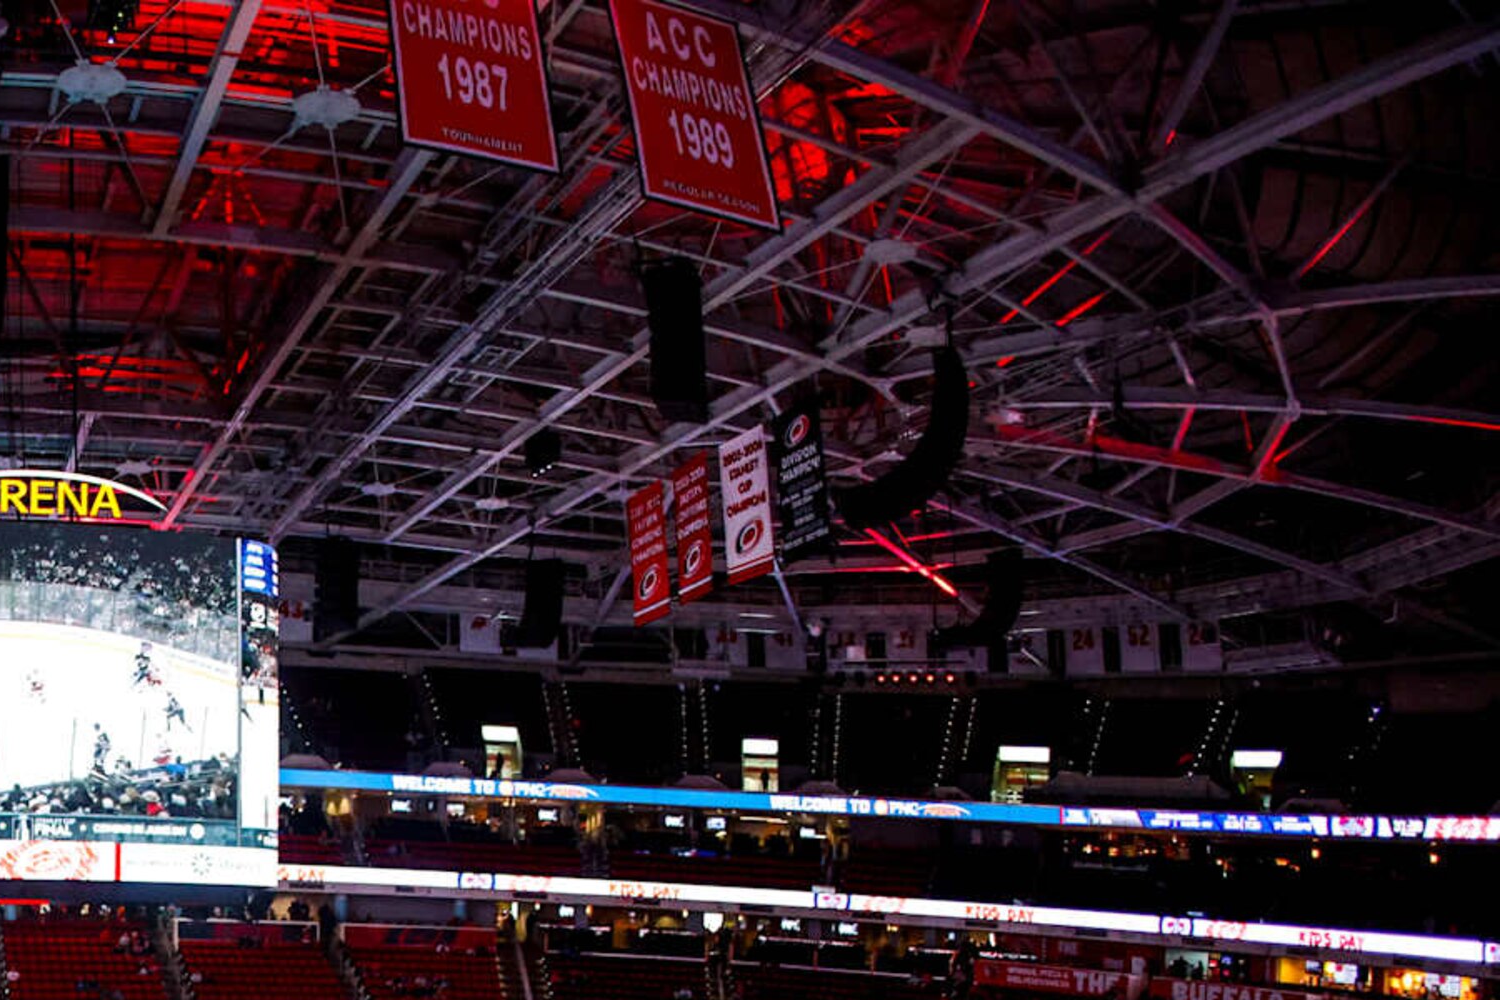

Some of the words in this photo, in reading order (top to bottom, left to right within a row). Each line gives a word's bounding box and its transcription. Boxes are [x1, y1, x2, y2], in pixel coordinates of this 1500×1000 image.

[403, 1, 532, 61] CHAMPIONS
[646, 10, 716, 68] ACC
[437, 53, 508, 112] 1987
[633, 56, 747, 121] CHAMPIONS
[668, 108, 734, 169] 1989
[392, 775, 471, 793] WELCOME
[474, 780, 496, 795] TO
[515, 782, 545, 797] PNC
[770, 795, 848, 813] WELCOME
[851, 798, 871, 814] TO
[889, 801, 919, 816] PNC
[1008, 908, 1034, 923] DAY
[1339, 934, 1365, 952] DAY
